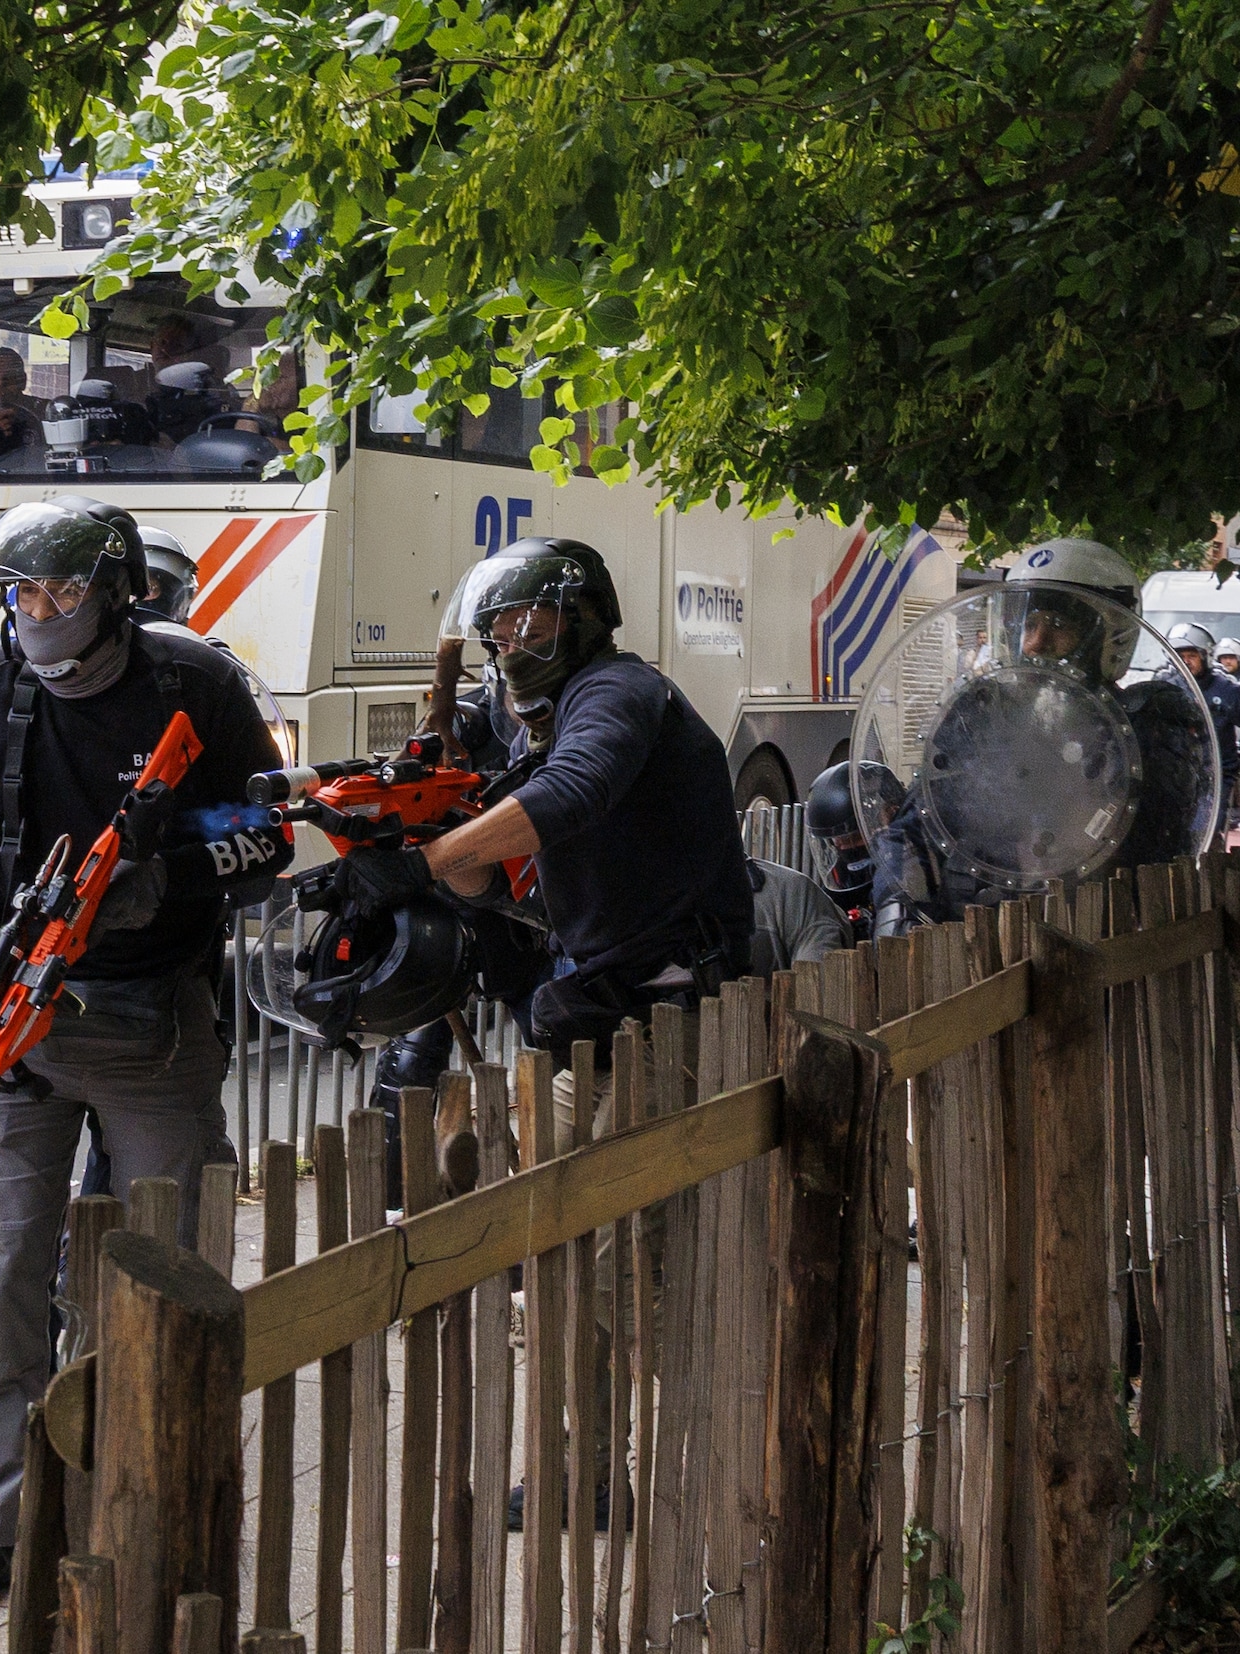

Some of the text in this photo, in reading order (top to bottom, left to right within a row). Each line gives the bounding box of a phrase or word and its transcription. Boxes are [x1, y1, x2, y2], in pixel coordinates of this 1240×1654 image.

[697, 586, 744, 623] Politie
[368, 624, 385, 641] 101
[133, 752, 153, 767] BA
[118, 770, 143, 782] Polit
[205, 826, 277, 876] BAB
